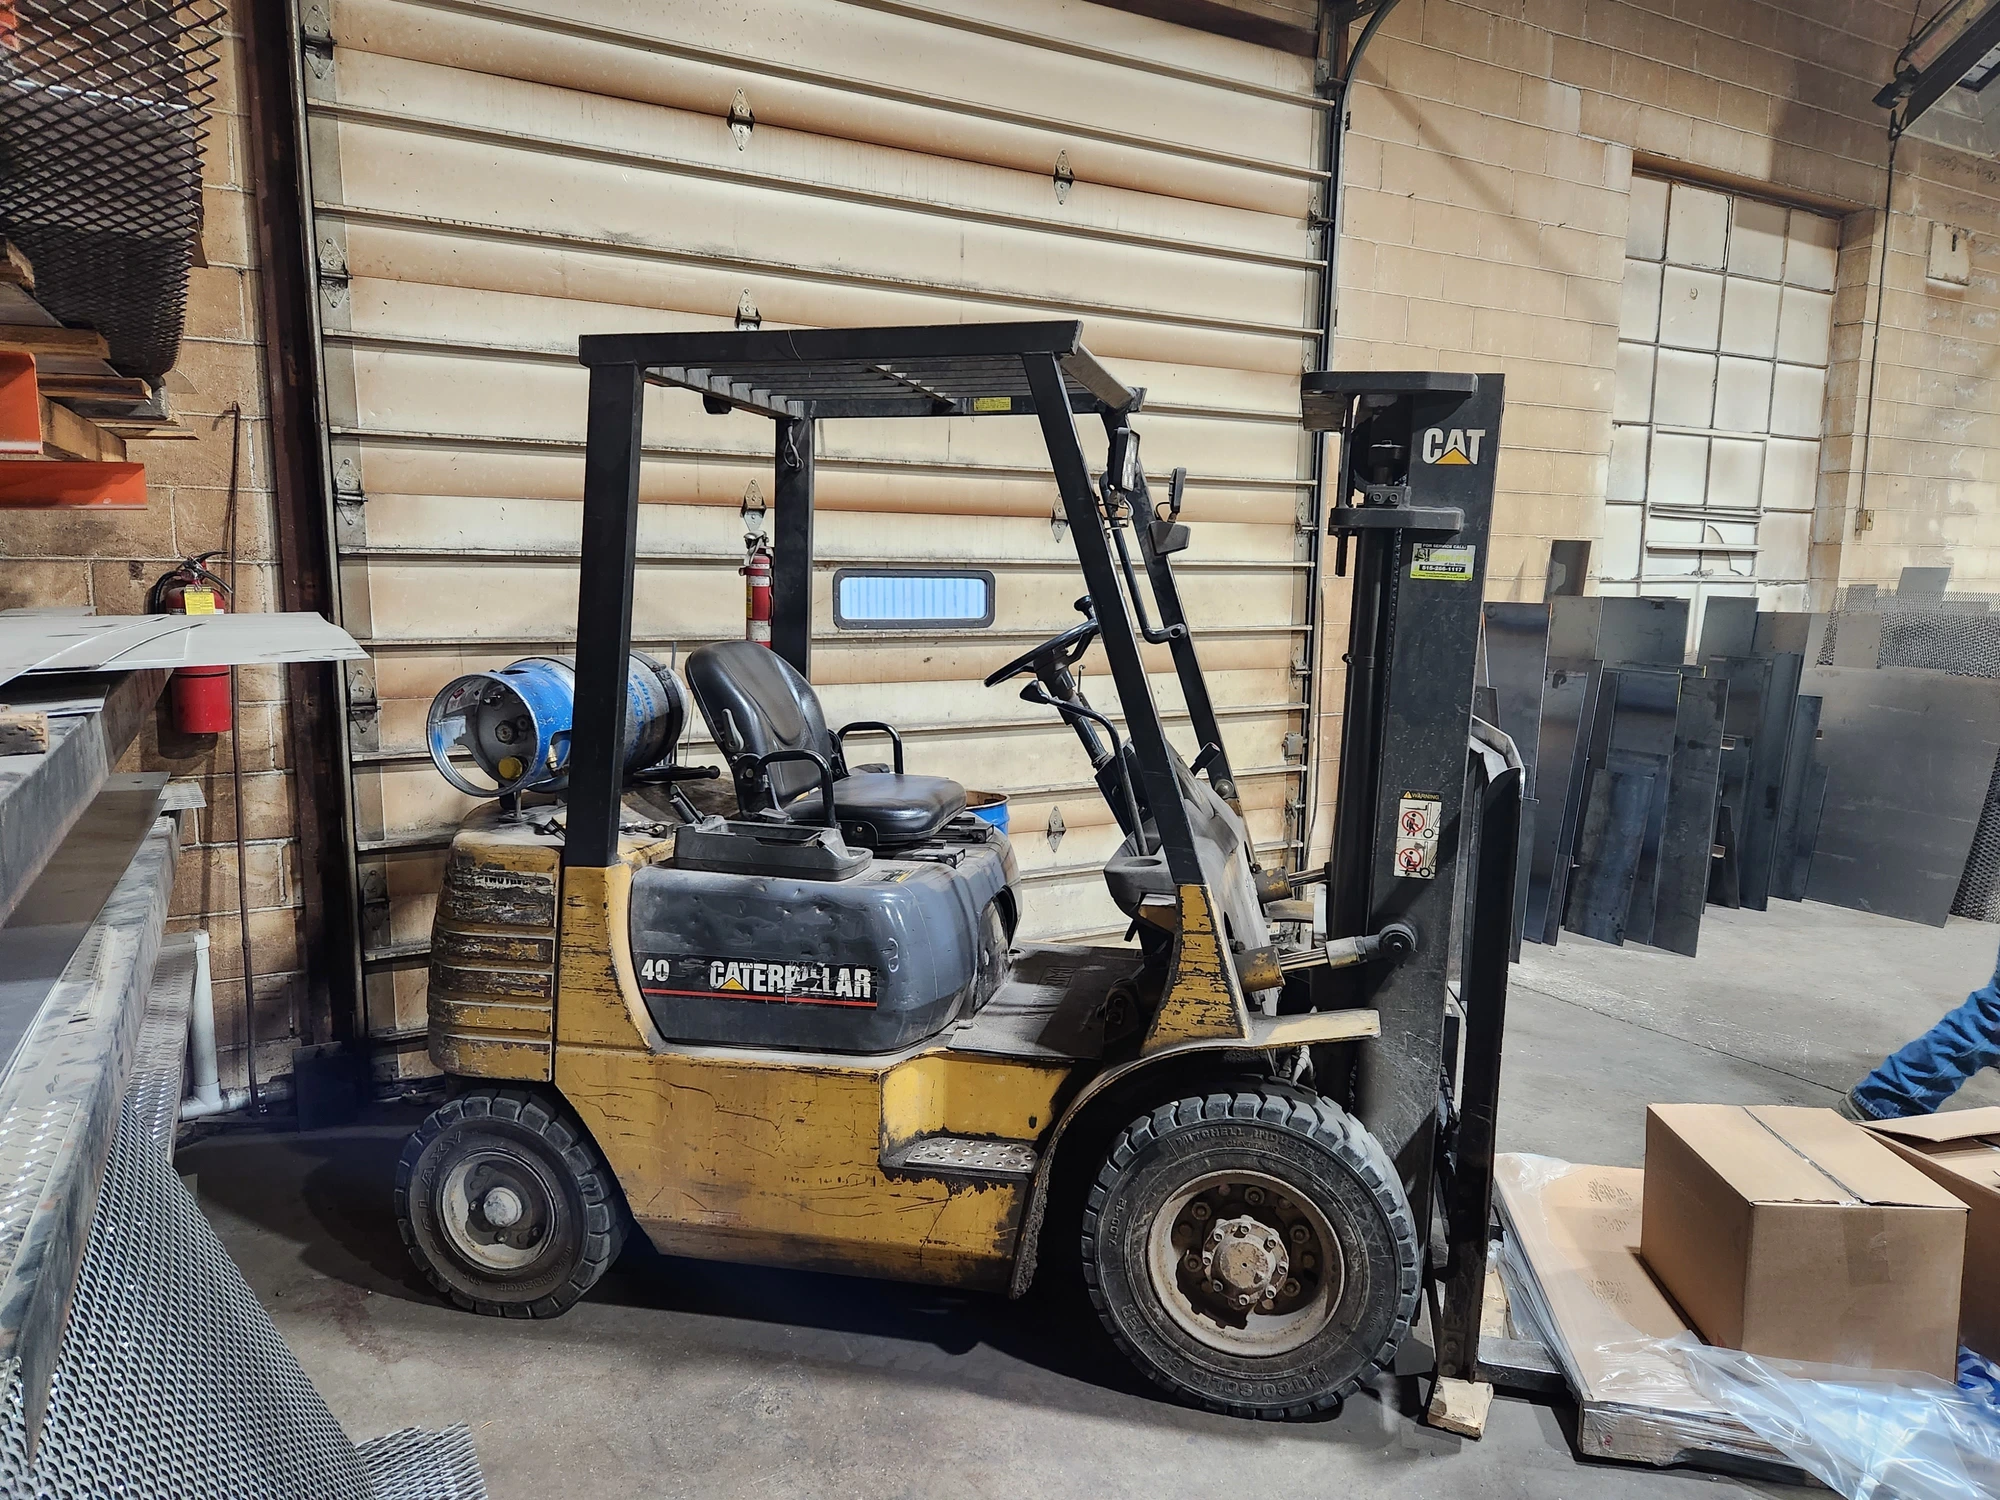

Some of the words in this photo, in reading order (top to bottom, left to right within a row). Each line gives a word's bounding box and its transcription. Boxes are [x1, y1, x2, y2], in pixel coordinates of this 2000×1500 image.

[1422, 427, 1486, 465] CAT
[1412, 792, 1440, 800] WARNING
[641, 959, 670, 982] 40
